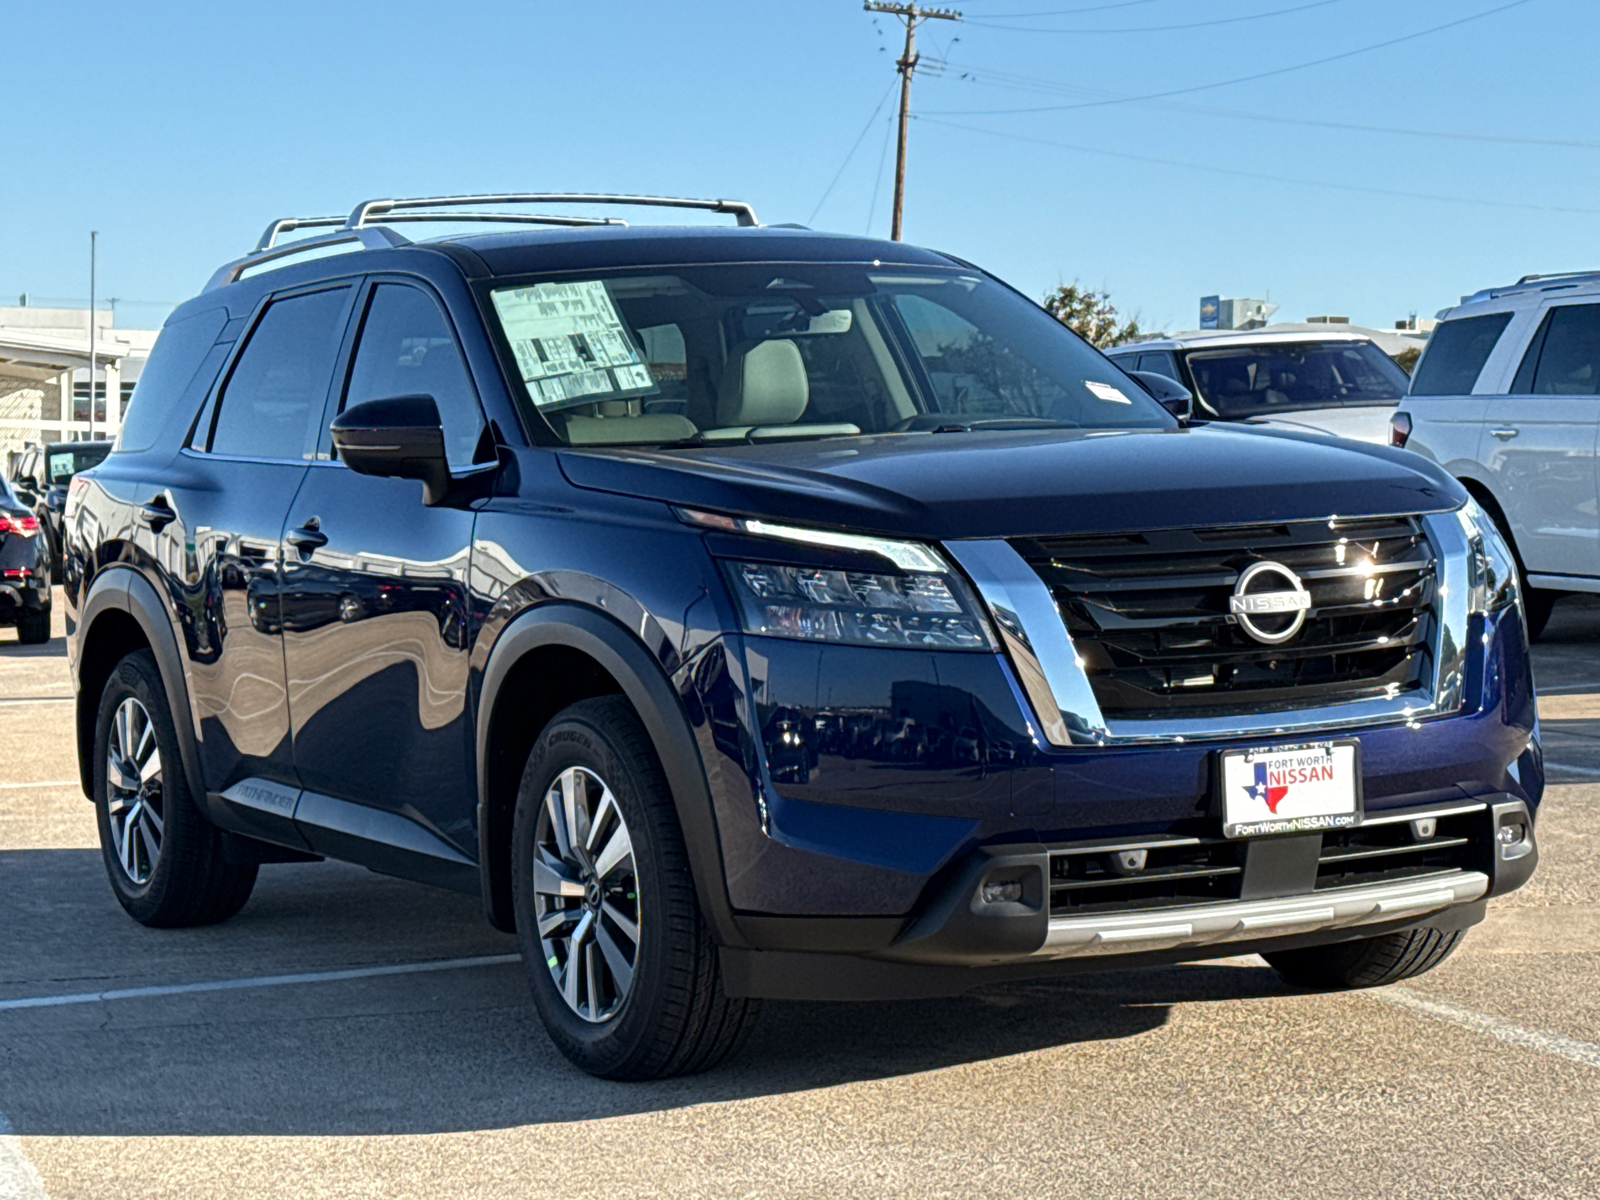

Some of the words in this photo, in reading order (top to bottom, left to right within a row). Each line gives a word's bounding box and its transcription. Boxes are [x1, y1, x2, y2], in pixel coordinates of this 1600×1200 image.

[1232, 595, 1308, 611] NISSAN
[1268, 758, 1294, 770] FORT
[1297, 755, 1333, 768] WORTH
[1269, 765, 1333, 785] NISSAN
